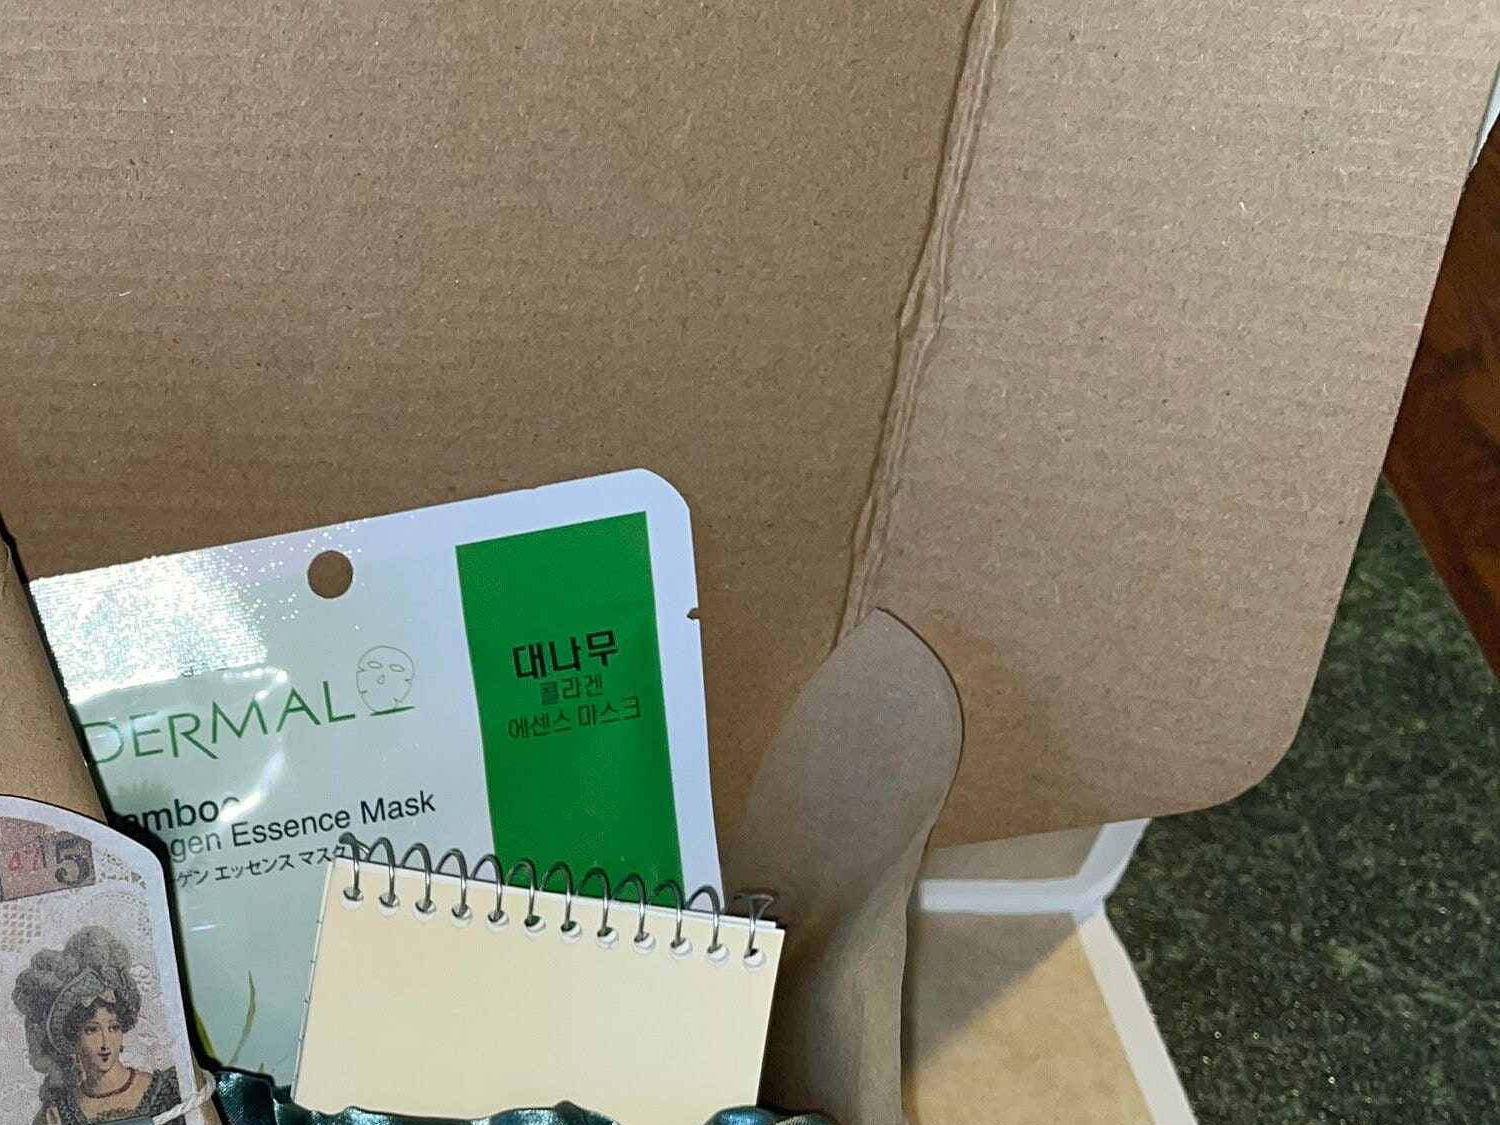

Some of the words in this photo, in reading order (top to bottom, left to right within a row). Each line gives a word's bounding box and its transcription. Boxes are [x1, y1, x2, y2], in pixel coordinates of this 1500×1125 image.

[512, 630, 618, 679] 대나무
[539, 673, 604, 706] 콜라겐
[82, 681, 356, 764] DERMAL
[507, 710, 572, 739] 에센스
[577, 696, 641, 727] 마스크
[231, 811, 350, 847] Essence
[360, 791, 436, 825] Mask
[54, 837, 92, 886] 5
